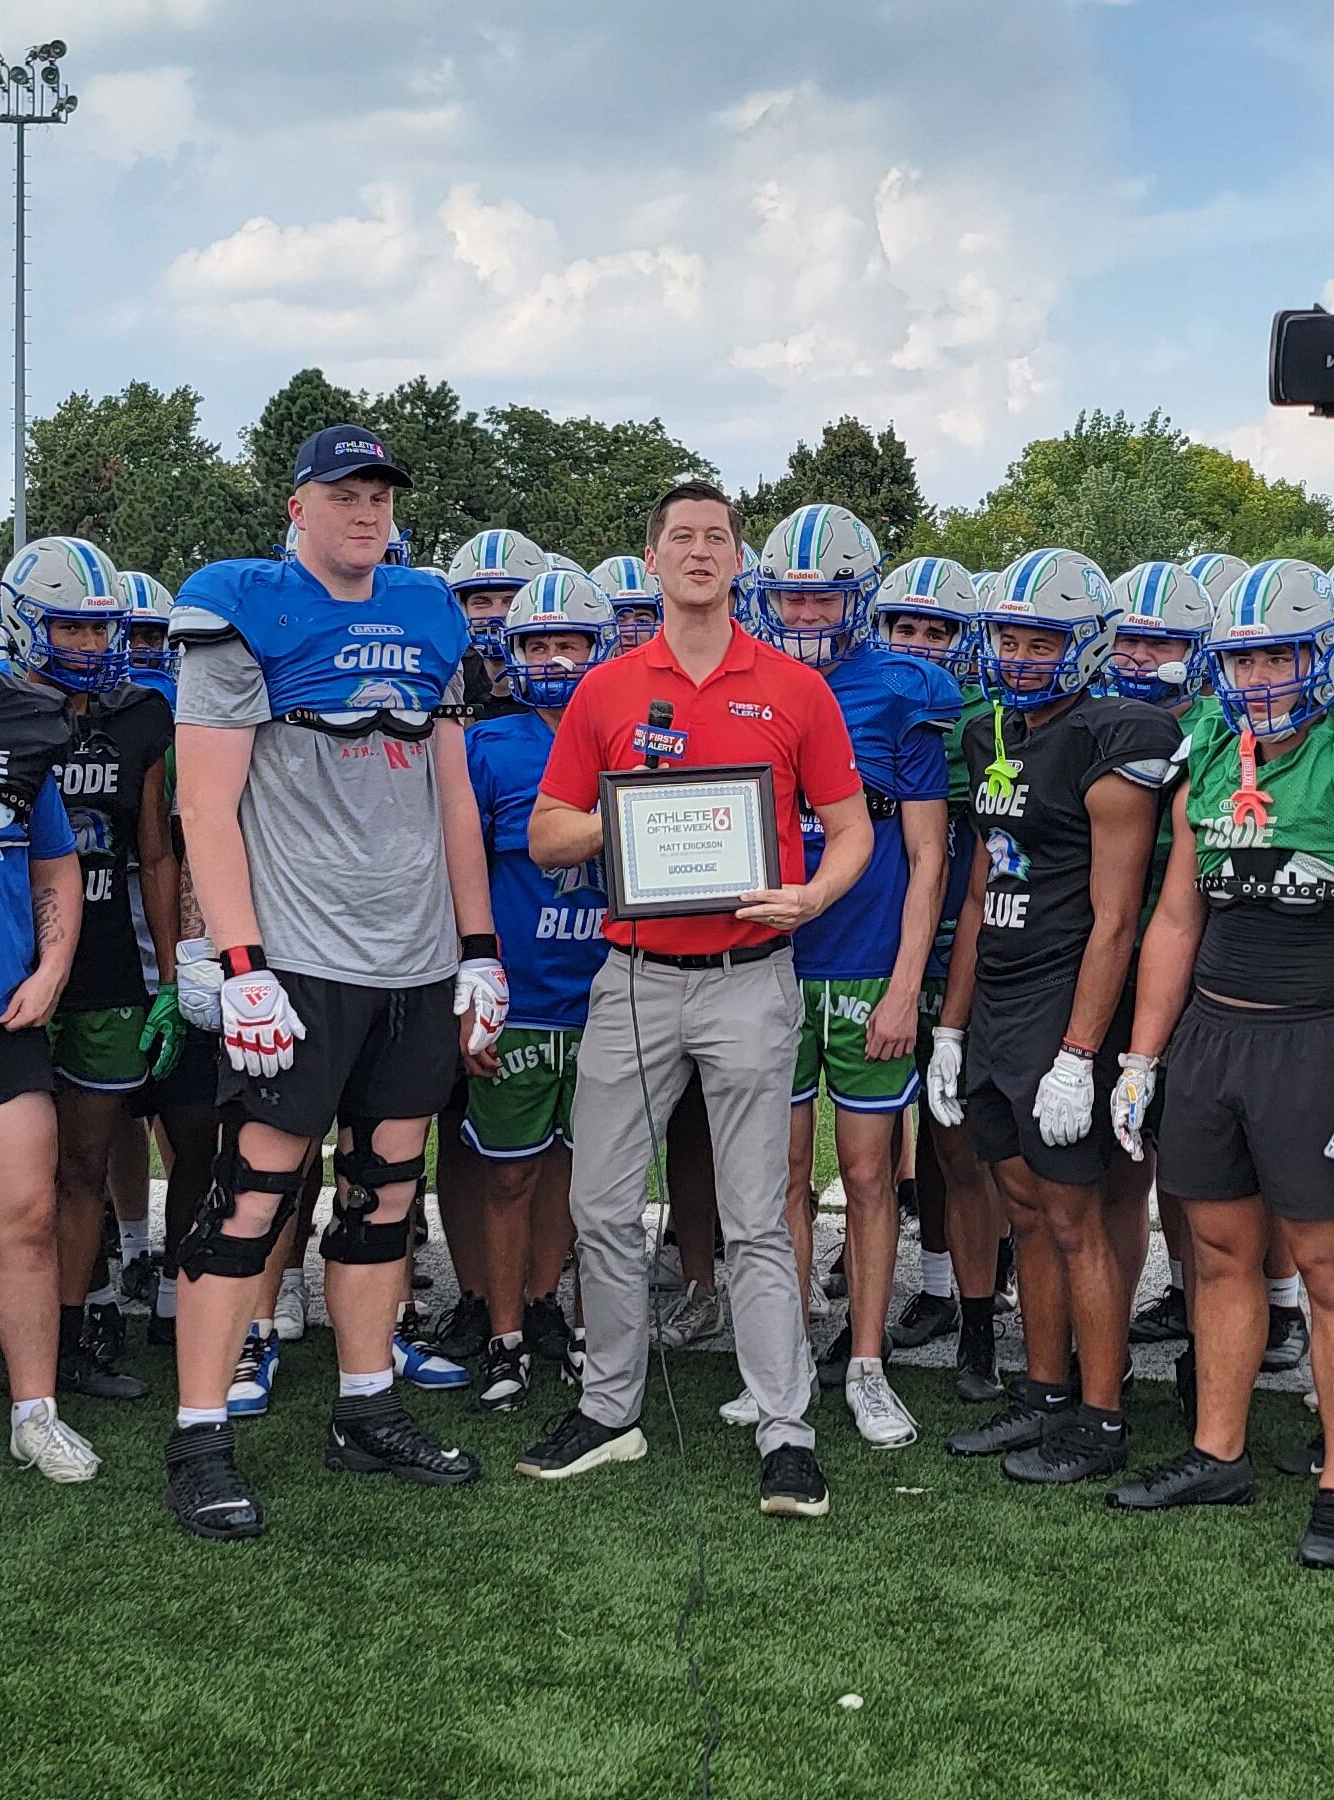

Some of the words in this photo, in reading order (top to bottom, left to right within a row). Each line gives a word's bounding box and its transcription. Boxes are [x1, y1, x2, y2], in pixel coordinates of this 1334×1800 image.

[335, 441, 375, 450] ATHLETE
[787, 571, 820, 580] Riddell
[904, 595, 935, 605] Riddell
[532, 613, 564, 622] Riddell
[1129, 616, 1162, 628] Riddell
[355, 626, 400, 634] BATTLE
[334, 641, 422, 673] CODE
[729, 701, 760, 711] FIRST
[762, 706, 773, 720] 6
[730, 709, 760, 718] ALERT
[648, 743, 673, 752] ALERT
[649, 732, 675, 744] FIRST
[674, 737, 684, 754] 6
[647, 810, 712, 824] ATHLETE
[715, 808, 730, 830] 6
[647, 826, 660, 834] OF
[661, 824, 682, 833] THE
[683, 823, 712, 832] WEEK
[659, 842, 681, 852] MATT
[683, 840, 723, 851] ERICKSON
[669, 863, 717, 874] WOODHOUSE
[83, 869, 113, 902] UE
[536, 907, 610, 940] BLUE
